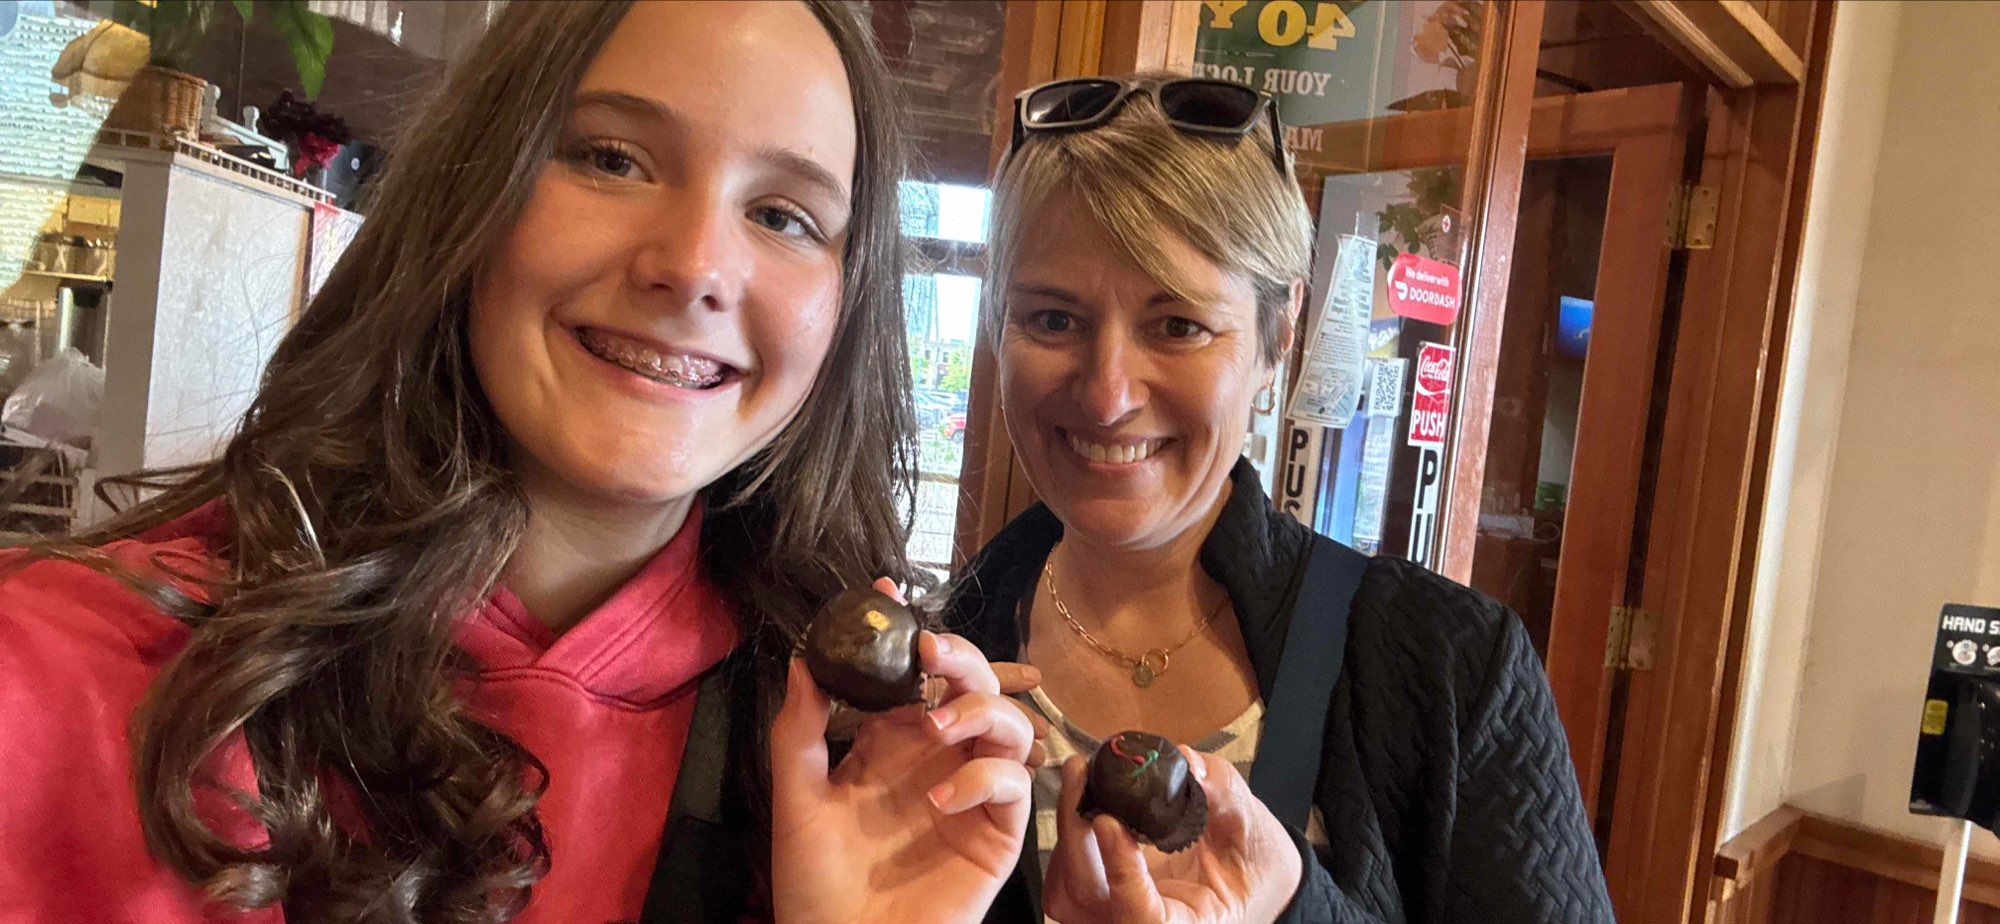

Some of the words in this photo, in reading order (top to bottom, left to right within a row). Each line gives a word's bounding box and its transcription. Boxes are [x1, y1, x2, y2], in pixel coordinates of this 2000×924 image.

[1405, 266, 1416, 279] We
[1416, 269, 1437, 285] deliver
[1436, 275, 1450, 288] with
[1409, 287, 1456, 309] DOORDASH
[1412, 409, 1447, 438] PUSH
[1942, 614, 1986, 634] HAND
